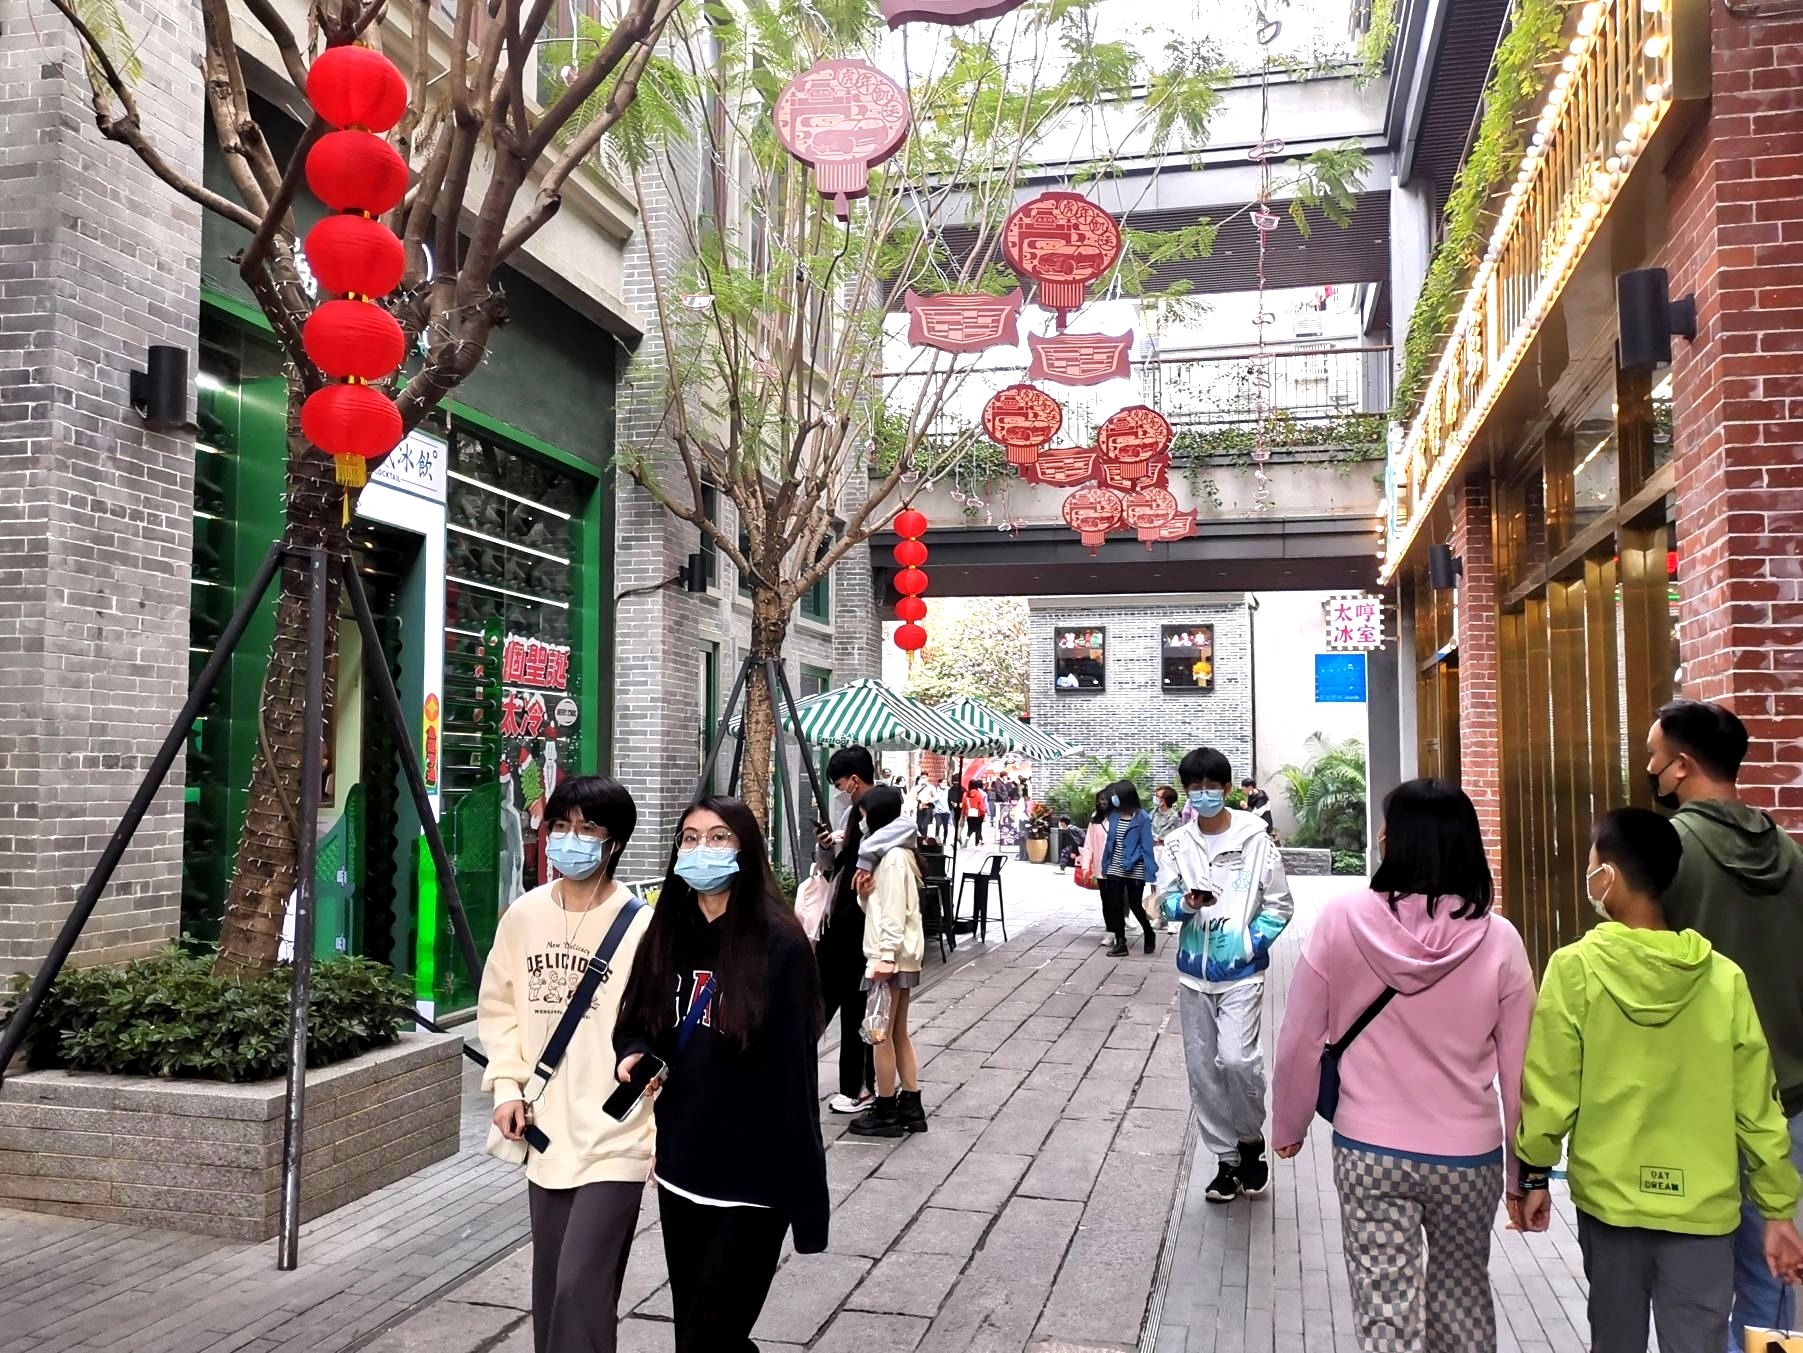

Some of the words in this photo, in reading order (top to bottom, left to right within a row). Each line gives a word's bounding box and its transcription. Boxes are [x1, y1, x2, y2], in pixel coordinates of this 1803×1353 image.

[1334, 602, 1375, 622] 太哼
[1333, 625, 1376, 643] 冰室
[501, 693, 546, 737] 太冷
[1650, 1170, 1671, 1180] DAY
[1644, 1180, 1680, 1192] DREAM
